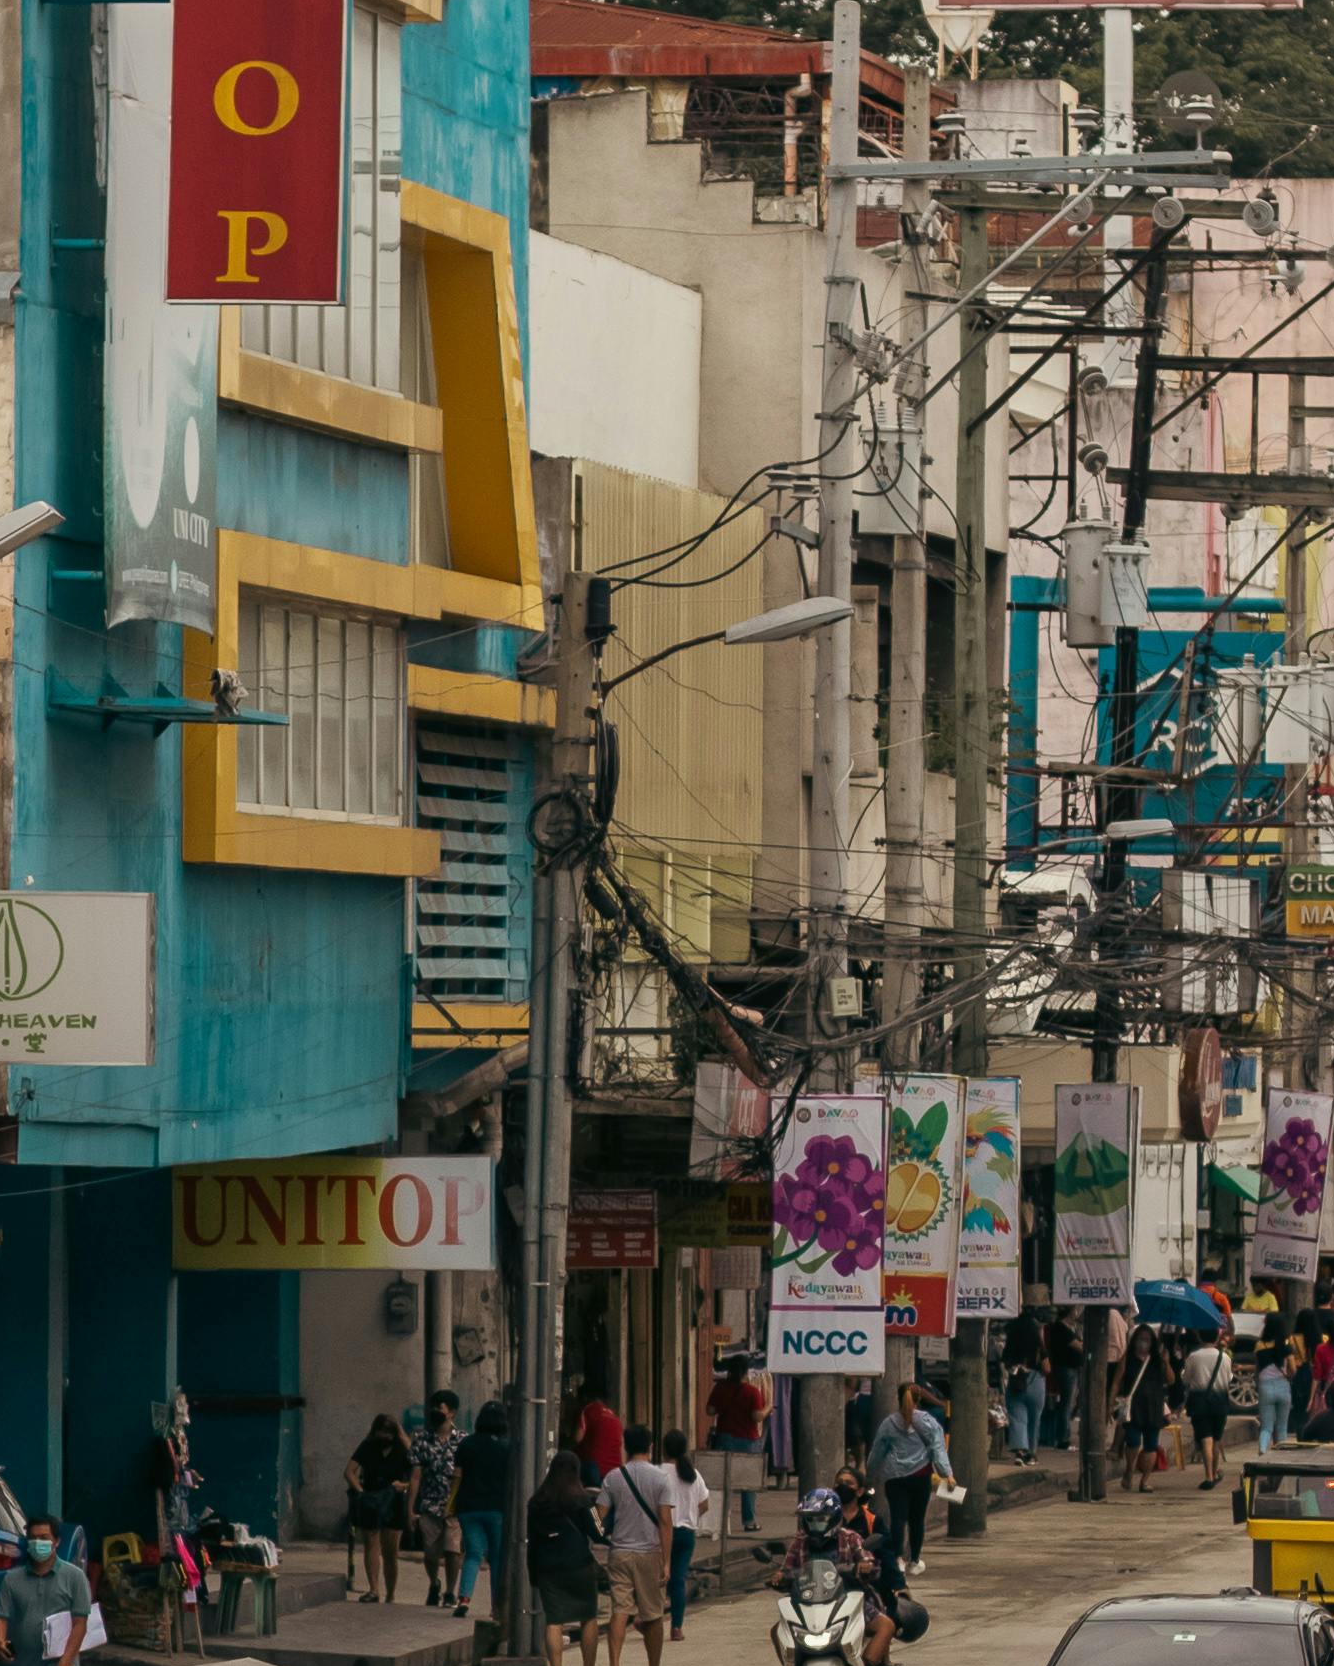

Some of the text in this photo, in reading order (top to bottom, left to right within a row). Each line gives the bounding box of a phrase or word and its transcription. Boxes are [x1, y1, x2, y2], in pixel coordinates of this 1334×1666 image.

[176, 1173, 484, 1247] UNITOP
[787, 1281, 864, 1300] Kadayawan
[957, 1287, 1007, 1296] NVERGE
[782, 1329, 868, 1355] NCCC
